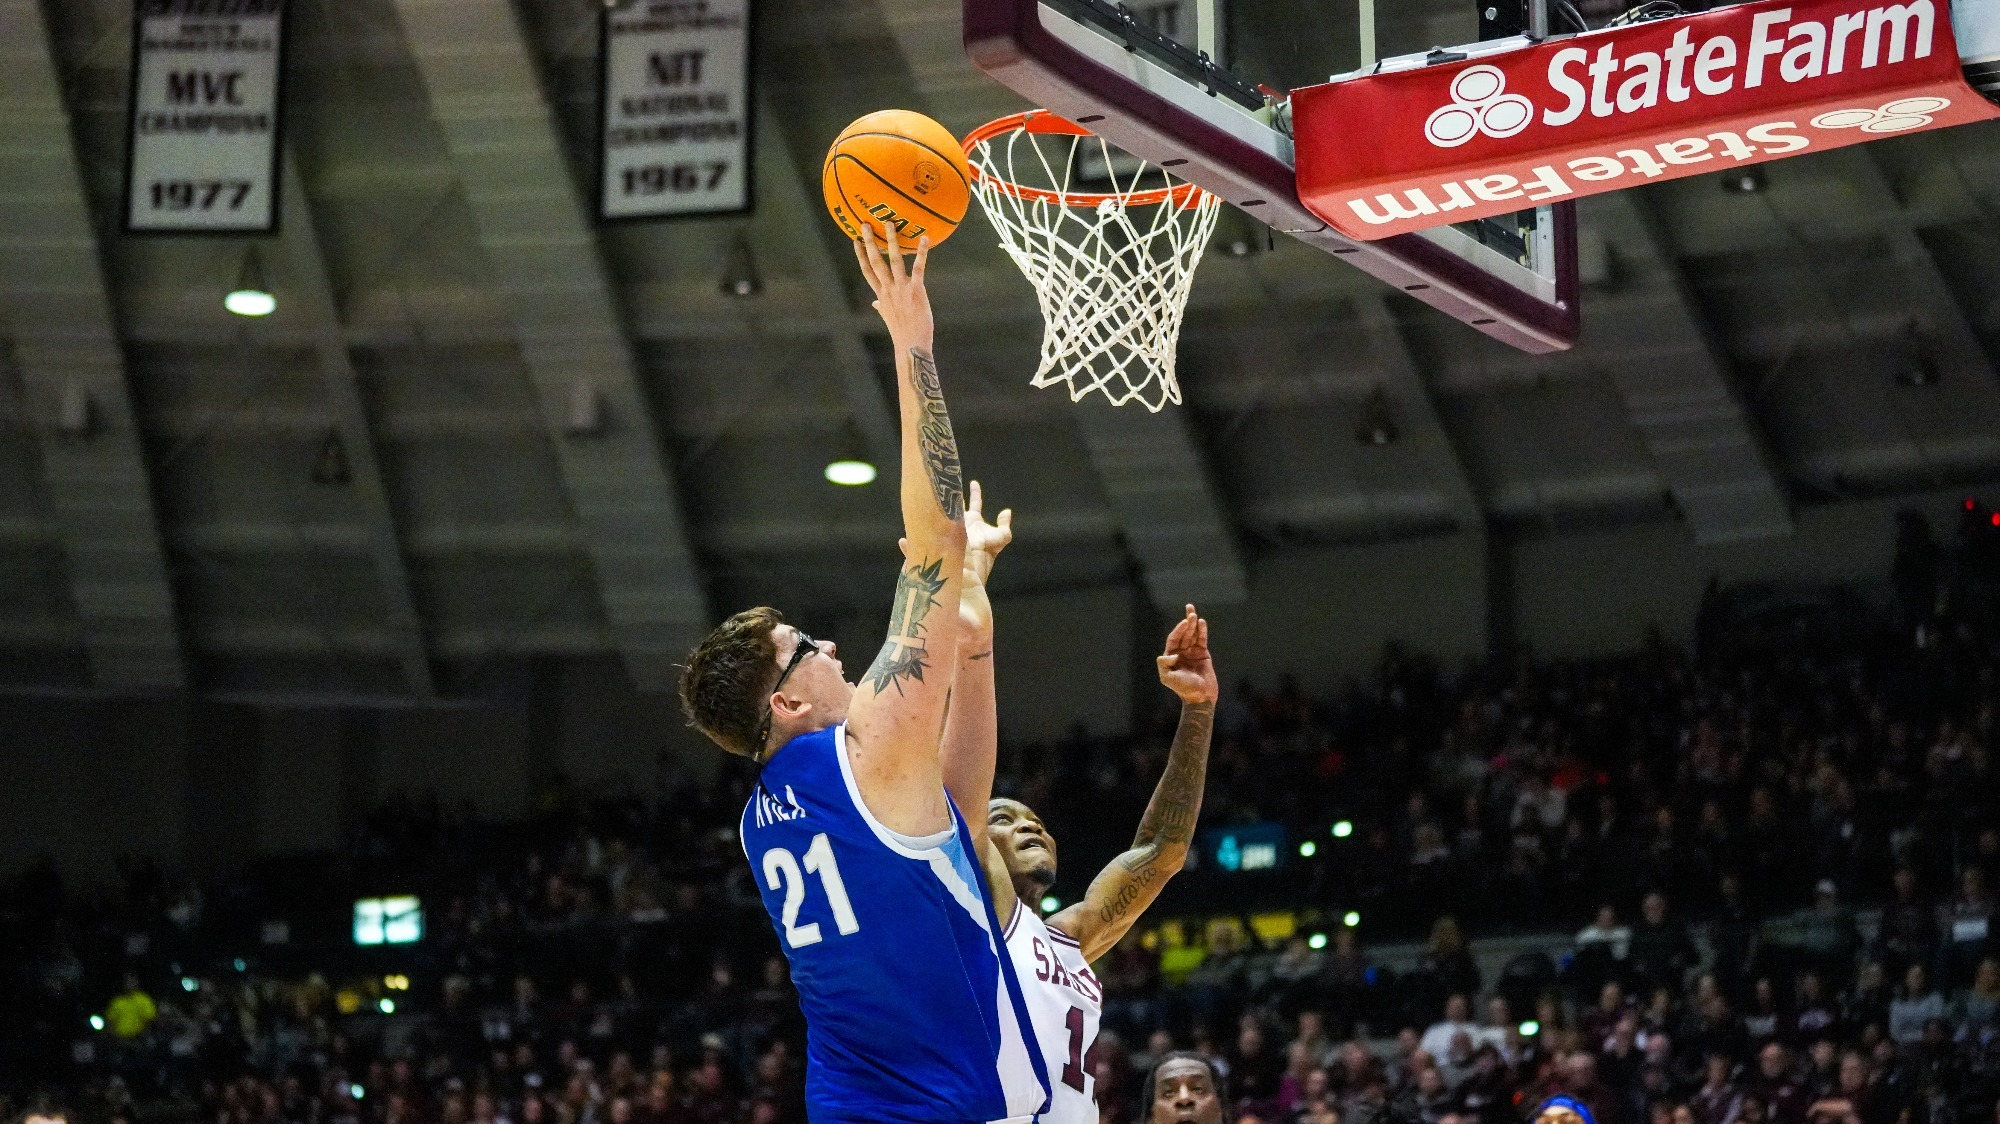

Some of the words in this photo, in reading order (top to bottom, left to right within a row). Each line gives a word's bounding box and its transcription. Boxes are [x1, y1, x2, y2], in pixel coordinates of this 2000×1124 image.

[648, 49, 708, 87] NIT
[167, 71, 244, 106] MVC
[151, 181, 253, 210] 1977
[622, 160, 730, 197] 1967
[868, 202, 927, 239] EVO
[763, 833, 860, 949] 21
